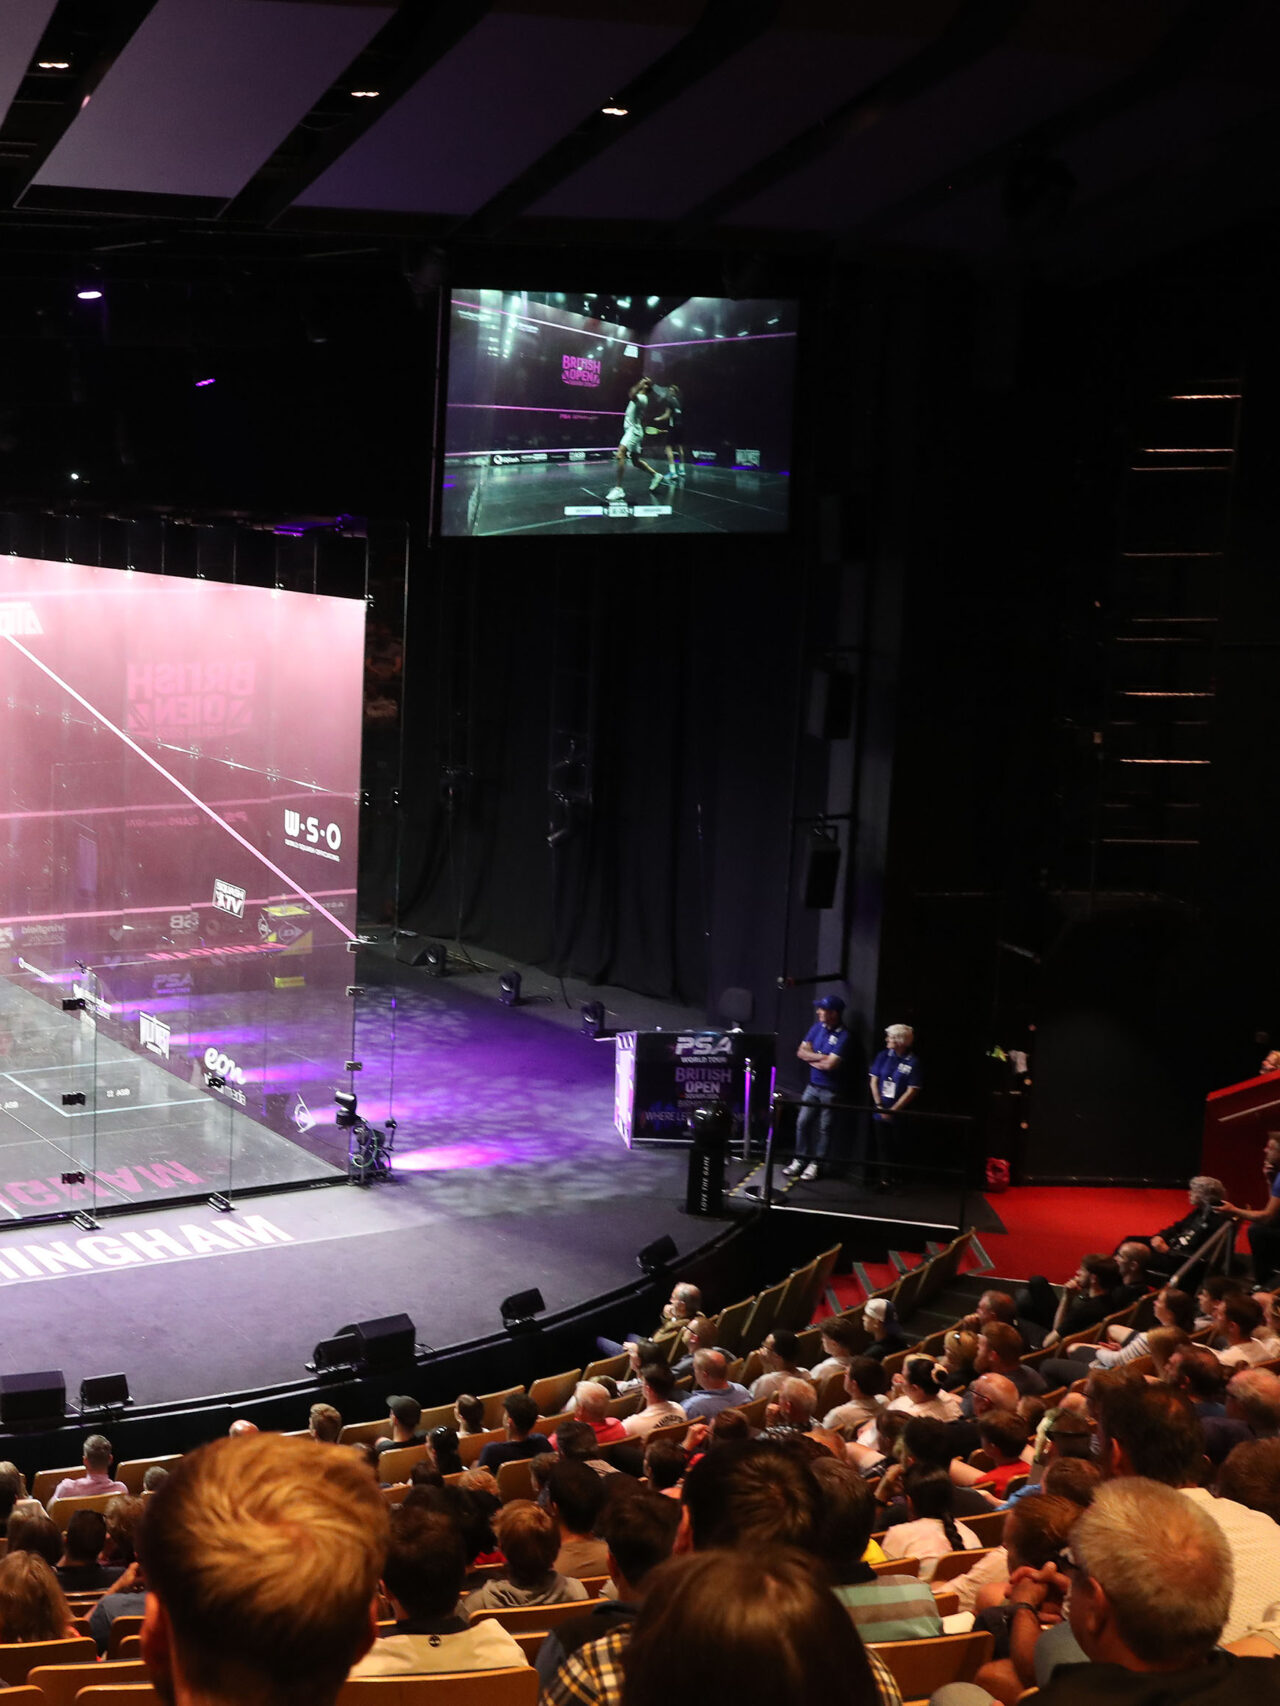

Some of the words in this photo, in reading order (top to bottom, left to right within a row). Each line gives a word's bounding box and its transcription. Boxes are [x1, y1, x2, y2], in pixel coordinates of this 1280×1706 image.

[562, 354, 601, 375] BRITISH
[675, 1036, 733, 1055] PSA
[675, 1066, 732, 1083] BRITISH
[686, 1081, 720, 1094] OPEN
